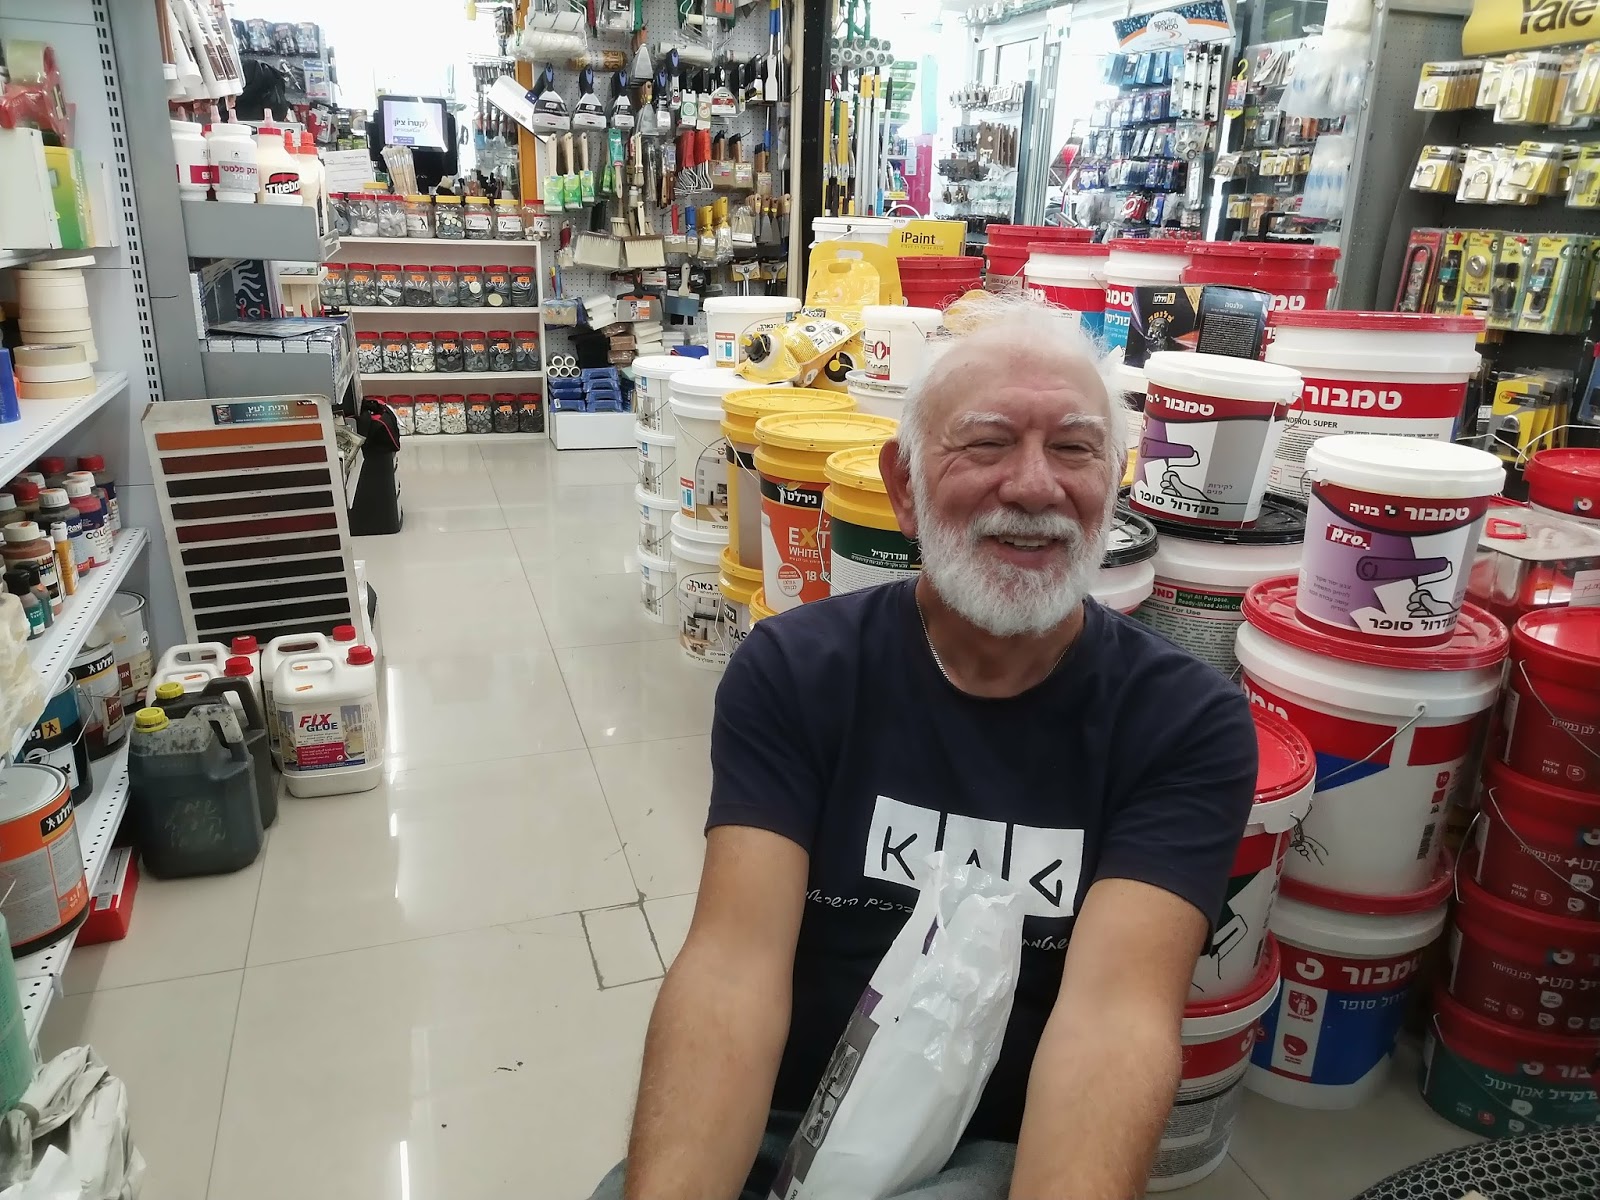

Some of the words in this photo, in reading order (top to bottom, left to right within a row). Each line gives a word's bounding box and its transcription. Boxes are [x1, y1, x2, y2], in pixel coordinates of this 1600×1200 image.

[1520, 0, 1597, 34] Yale
[901, 231, 936, 244] iPaint
[1305, 385, 1402, 411] טמבור
[1163, 396, 1214, 416] טמבור
[1313, 419, 1338, 428] SUPER
[1208, 483, 1233, 491] לקירות
[787, 490, 817, 504] נירלט
[1140, 490, 1165, 505] סופר
[1170, 498, 1219, 515] בונדרול
[1349, 503, 1380, 517] בניה
[1404, 507, 1470, 521] טמבור
[789, 546, 819, 559] WHITE
[871, 549, 908, 560] וונדרקריל
[805, 570, 817, 581] 18
[1186, 608, 1201, 616] Use
[1369, 617, 1413, 631] סופר
[299, 713, 332, 728] FIX
[306, 722, 338, 732] GLUE
[1580, 725, 1595, 735] לבן
[1541, 765, 1558, 775] 1936
[1339, 999, 1376, 1010] סופר
